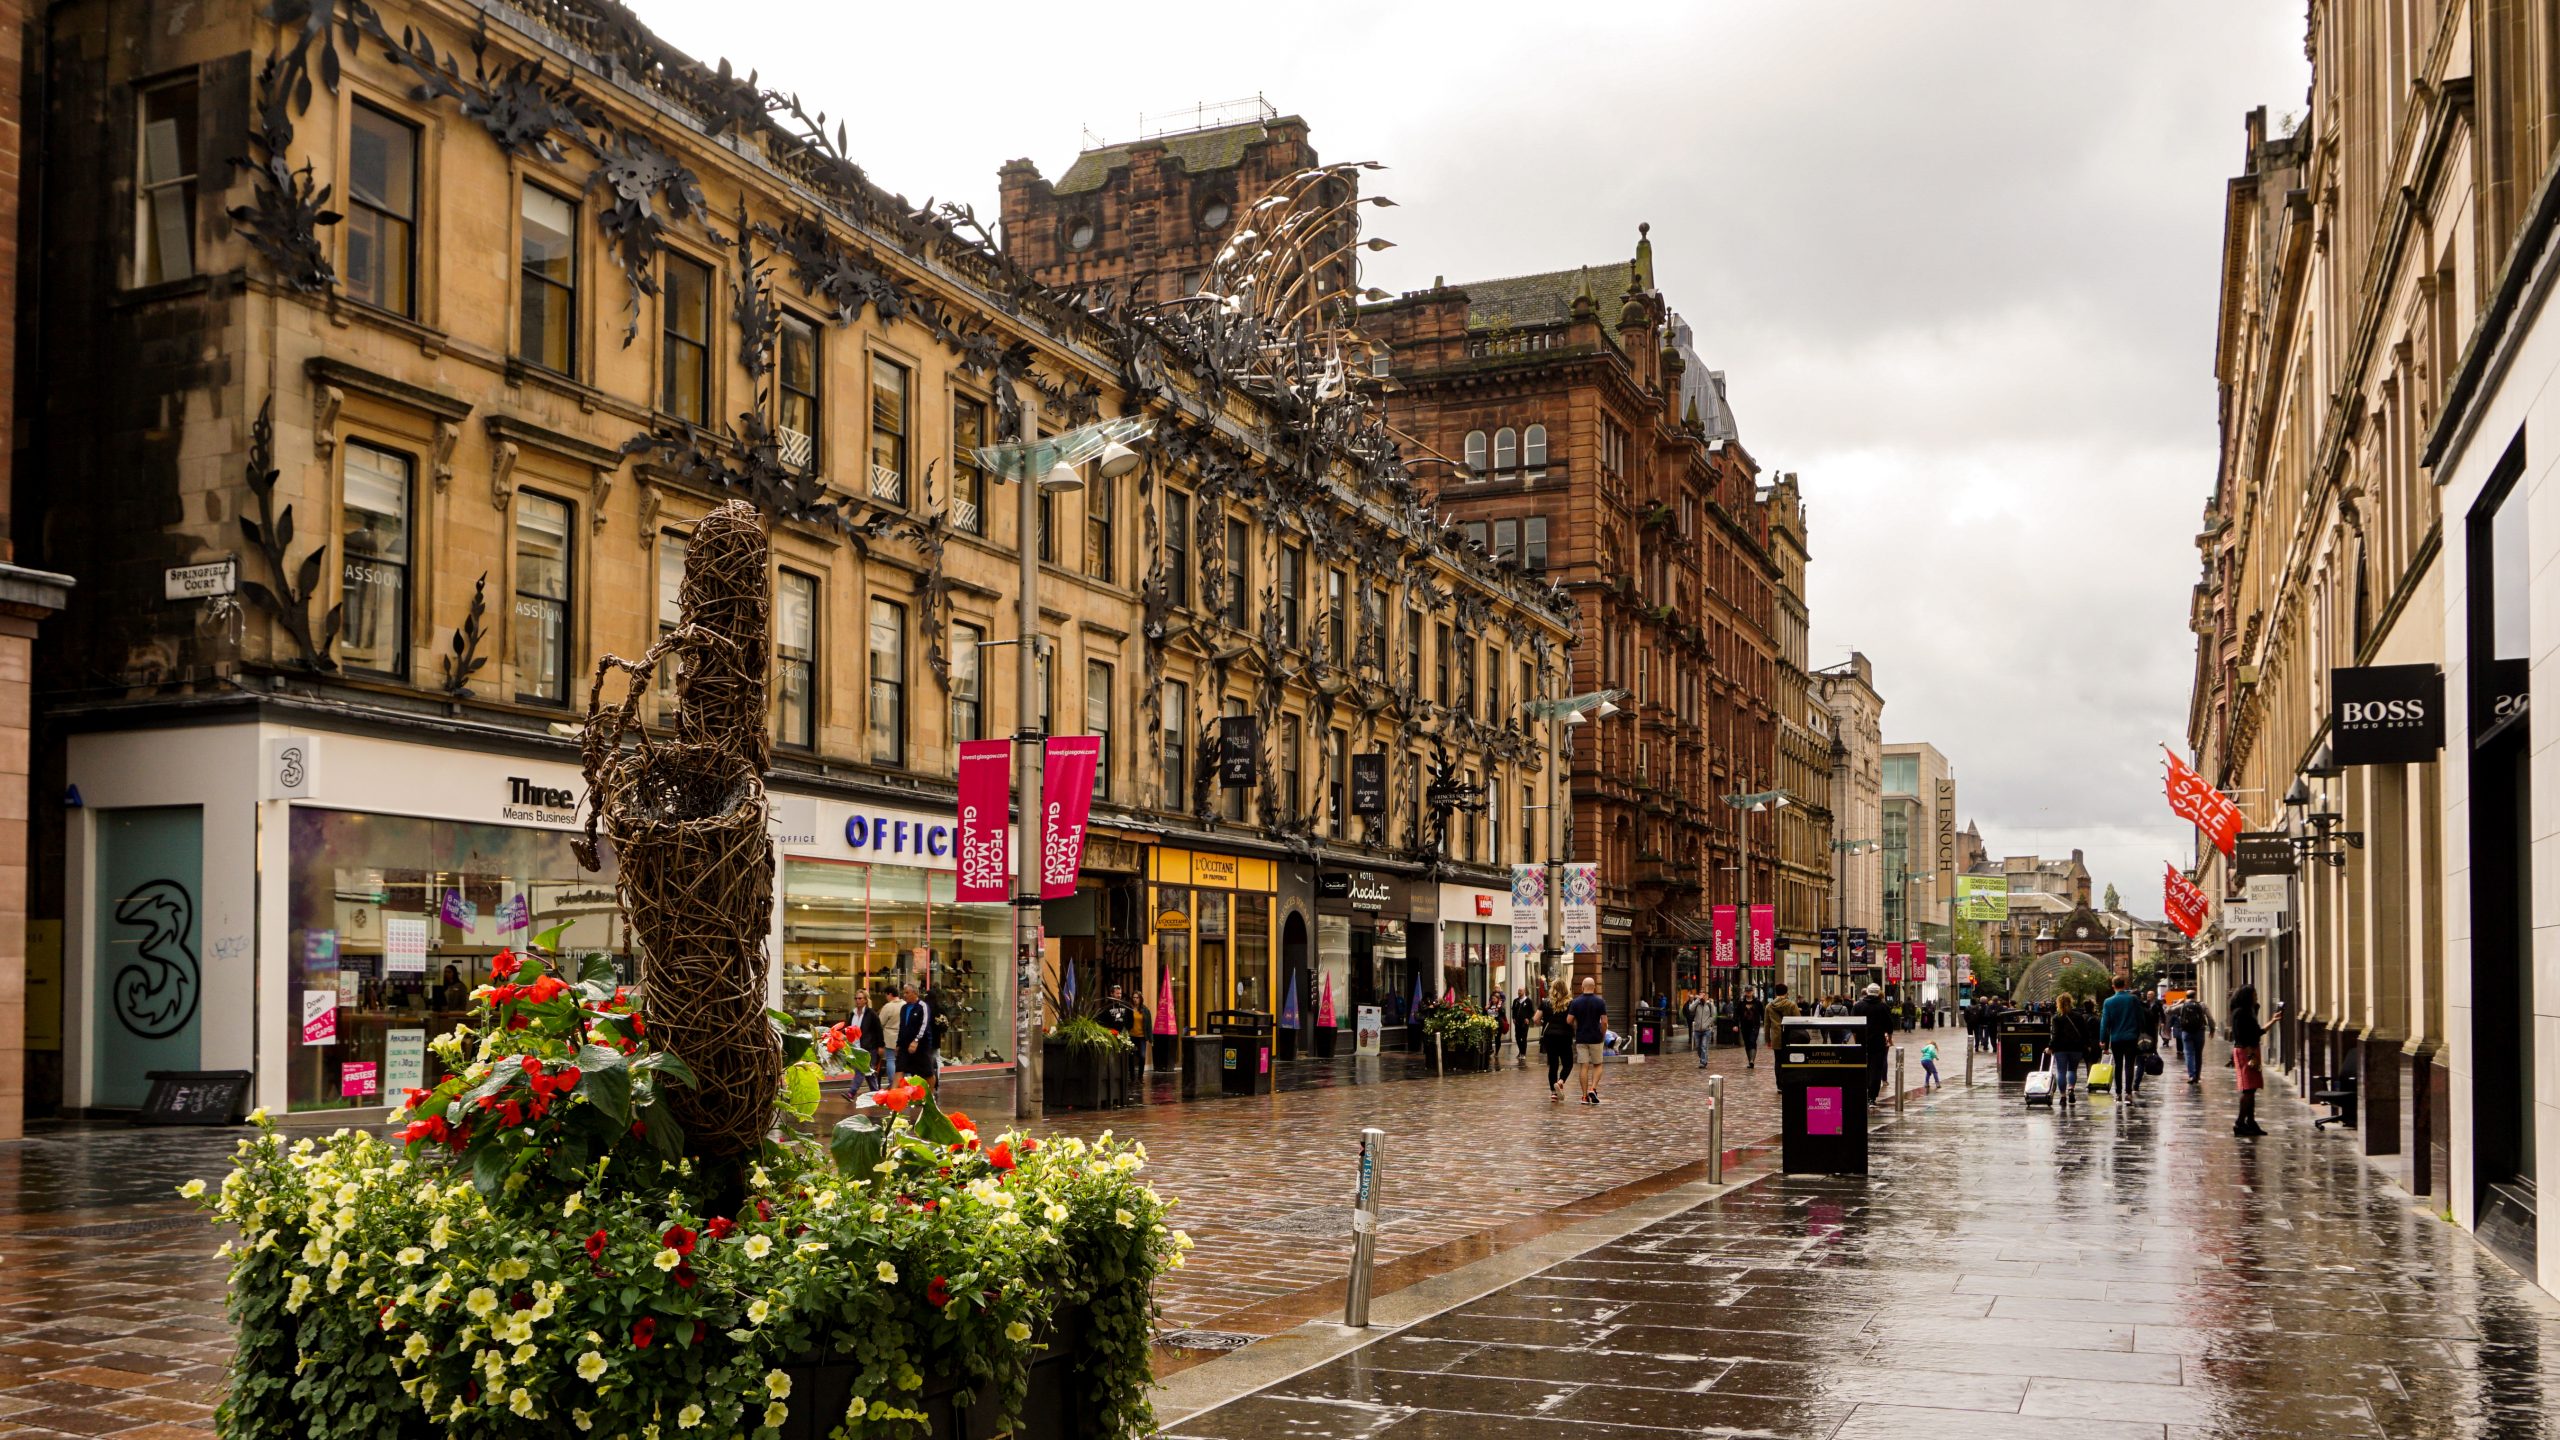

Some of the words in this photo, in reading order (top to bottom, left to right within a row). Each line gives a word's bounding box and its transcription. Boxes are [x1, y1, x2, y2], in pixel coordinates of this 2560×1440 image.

[184, 579, 216, 590] COURT
[2342, 699, 2425, 723] BOSS
[2343, 722, 2379, 730] HUGO
[2387, 720, 2424, 728] BOSS
[1227, 757, 1250, 765] shopping
[1229, 772, 1247, 780] dining
[1356, 788, 1379, 796] shopping
[1359, 801, 1375, 809] dining
[2175, 780, 2228, 831] SALE
[502, 807, 534, 821] Means
[536, 810, 576, 825] Business
[780, 835, 815, 843] OFFICE
[1044, 802, 1061, 885] GLASGOW
[1939, 809, 1952, 871] ENOCH
[962, 806, 977, 889] GLASGOW
[1063, 824, 1082, 884] PEOPLE
[976, 843, 990, 888] MAKE
[990, 829, 1003, 888] PEOPLE
[1054, 838, 1069, 885] MAKE
[1359, 872, 1375, 881] HOTEL
[2171, 873, 2208, 907] SALE
[2250, 884, 2284, 892] MOLTON
[2168, 885, 2201, 917] SALE
[565, 945, 572, 959] 6
[306, 994, 326, 1009] Down
[308, 1006, 323, 1018] with
[306, 1022, 323, 1035] DATA
[344, 1069, 377, 1082] FASTEST
[363, 1080, 376, 1089] 5G
[1360, 1168, 1372, 1201] FOLKETS
